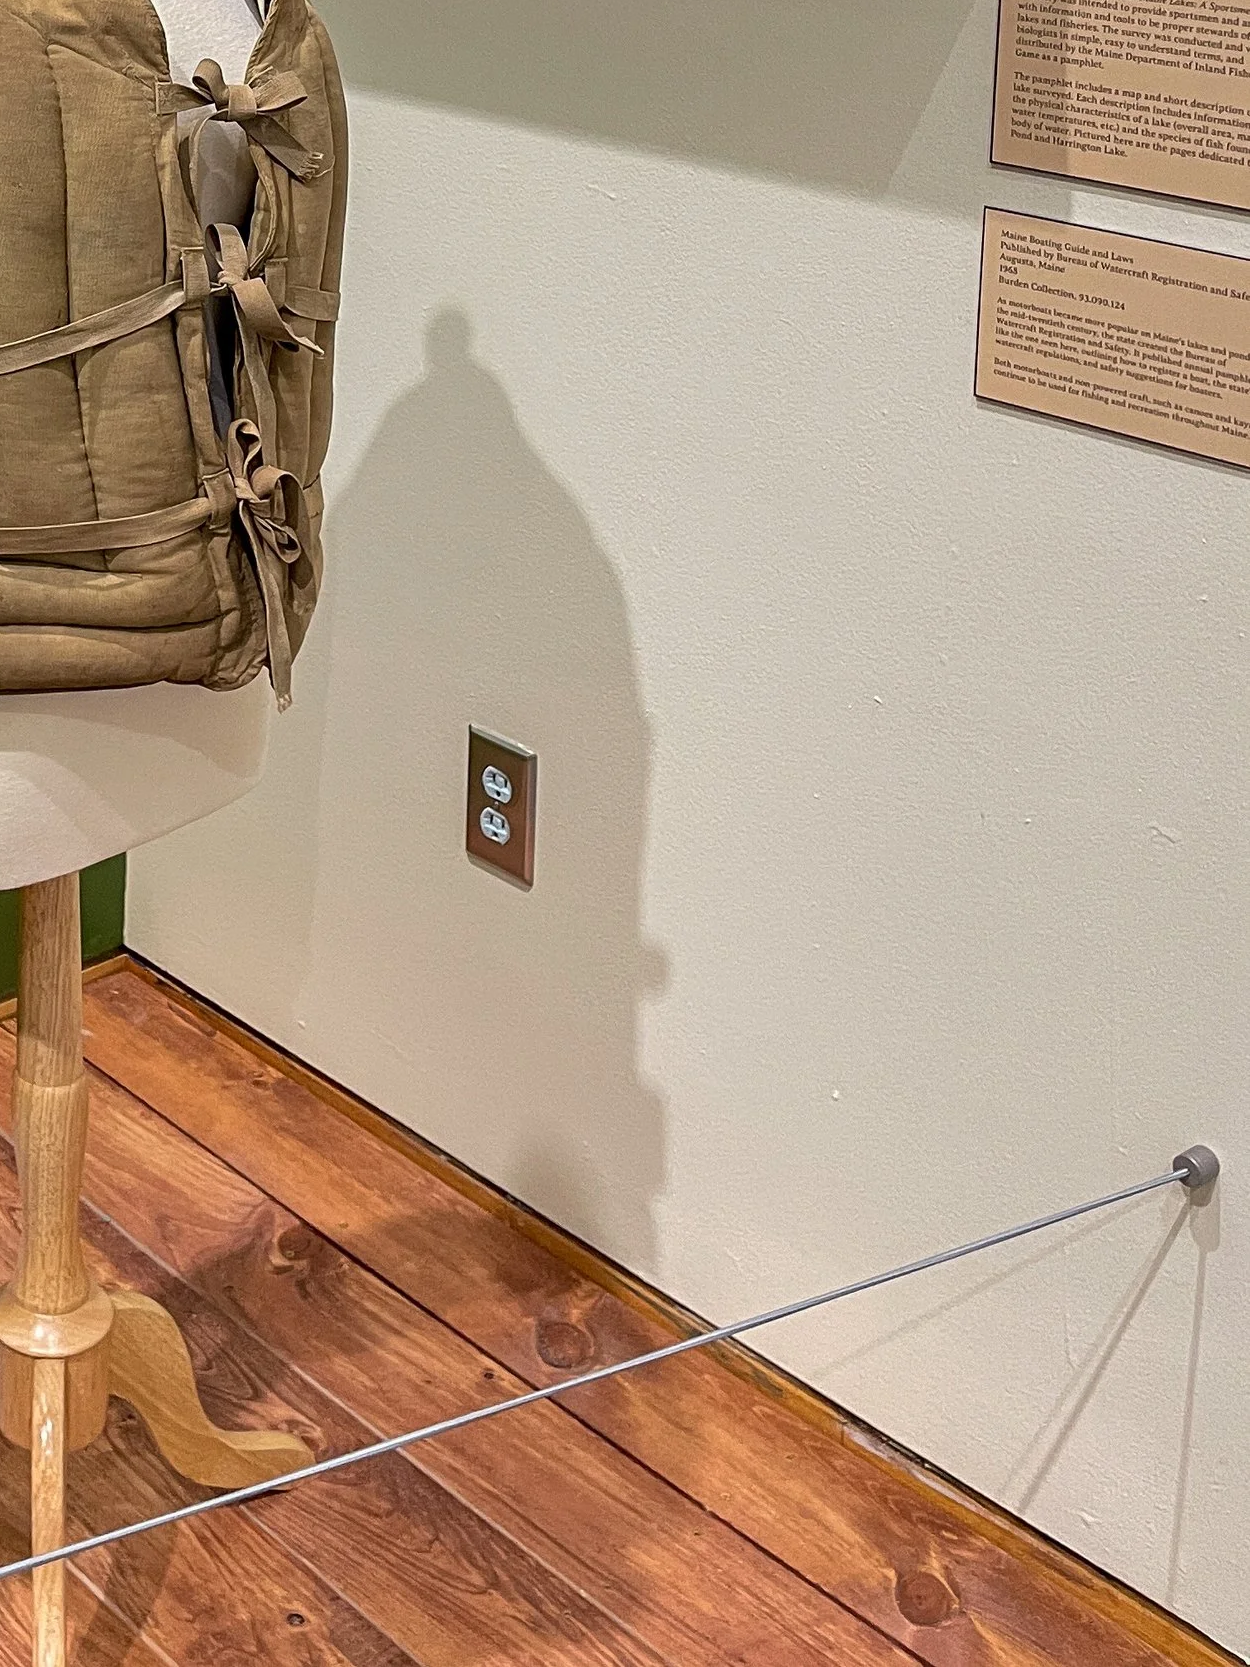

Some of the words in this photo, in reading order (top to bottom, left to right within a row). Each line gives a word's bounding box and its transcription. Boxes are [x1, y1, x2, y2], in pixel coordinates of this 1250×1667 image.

[1018, 2, 1037, 11] with
[1039, 4, 1091, 18] information
[1093, 12, 1110, 21] and
[1113, 14, 1135, 24] tools
[1137, 17, 1146, 26] to
[1148, 18, 1160, 27] be
[1161, 22, 1194, 33] proper
[1195, 25, 1238, 38] stewards
[1198, 0, 1207, 9] A
[1015, 47, 1039, 59] Game
[1060, 56, 1104, 68] pamphlet.
[1014, 70, 1030, 81] The
[1031, 76, 1072, 88] pamphlet
[1074, 81, 1112, 94] includes
[1121, 90, 1142, 101] map
[1143, 92, 1161, 102] and
[1163, 94, 1188, 106] short
[1189, 98, 1244, 115] description
[1010, 128, 1032, 140] Pond
[1034, 134, 1050, 143] and
[1052, 135, 1101, 152] Harrington
[1103, 144, 1127, 157] Lake.
[999, 251, 1036, 268] Augusta,
[1038, 259, 1065, 273] Maine
[1000, 228, 1027, 242] Maine
[1029, 234, 1062, 251] Boating
[1064, 241, 1090, 255] Guide
[1091, 249, 1109, 259] and
[1110, 251, 1133, 264] Laws
[1000, 240, 1041, 256] Published
[1043, 249, 1054, 261] by
[1056, 252, 1087, 266] Bureau
[1089, 260, 1099, 268] of
[1100, 261, 1148, 279] Watercraft
[1151, 272, 1208, 292] Registration
[1210, 286, 1228, 296] and
[998, 274, 1029, 288] Burden
[1030, 281, 1076, 300] Collection,
[1078, 292, 1125, 309] 93.090.124
